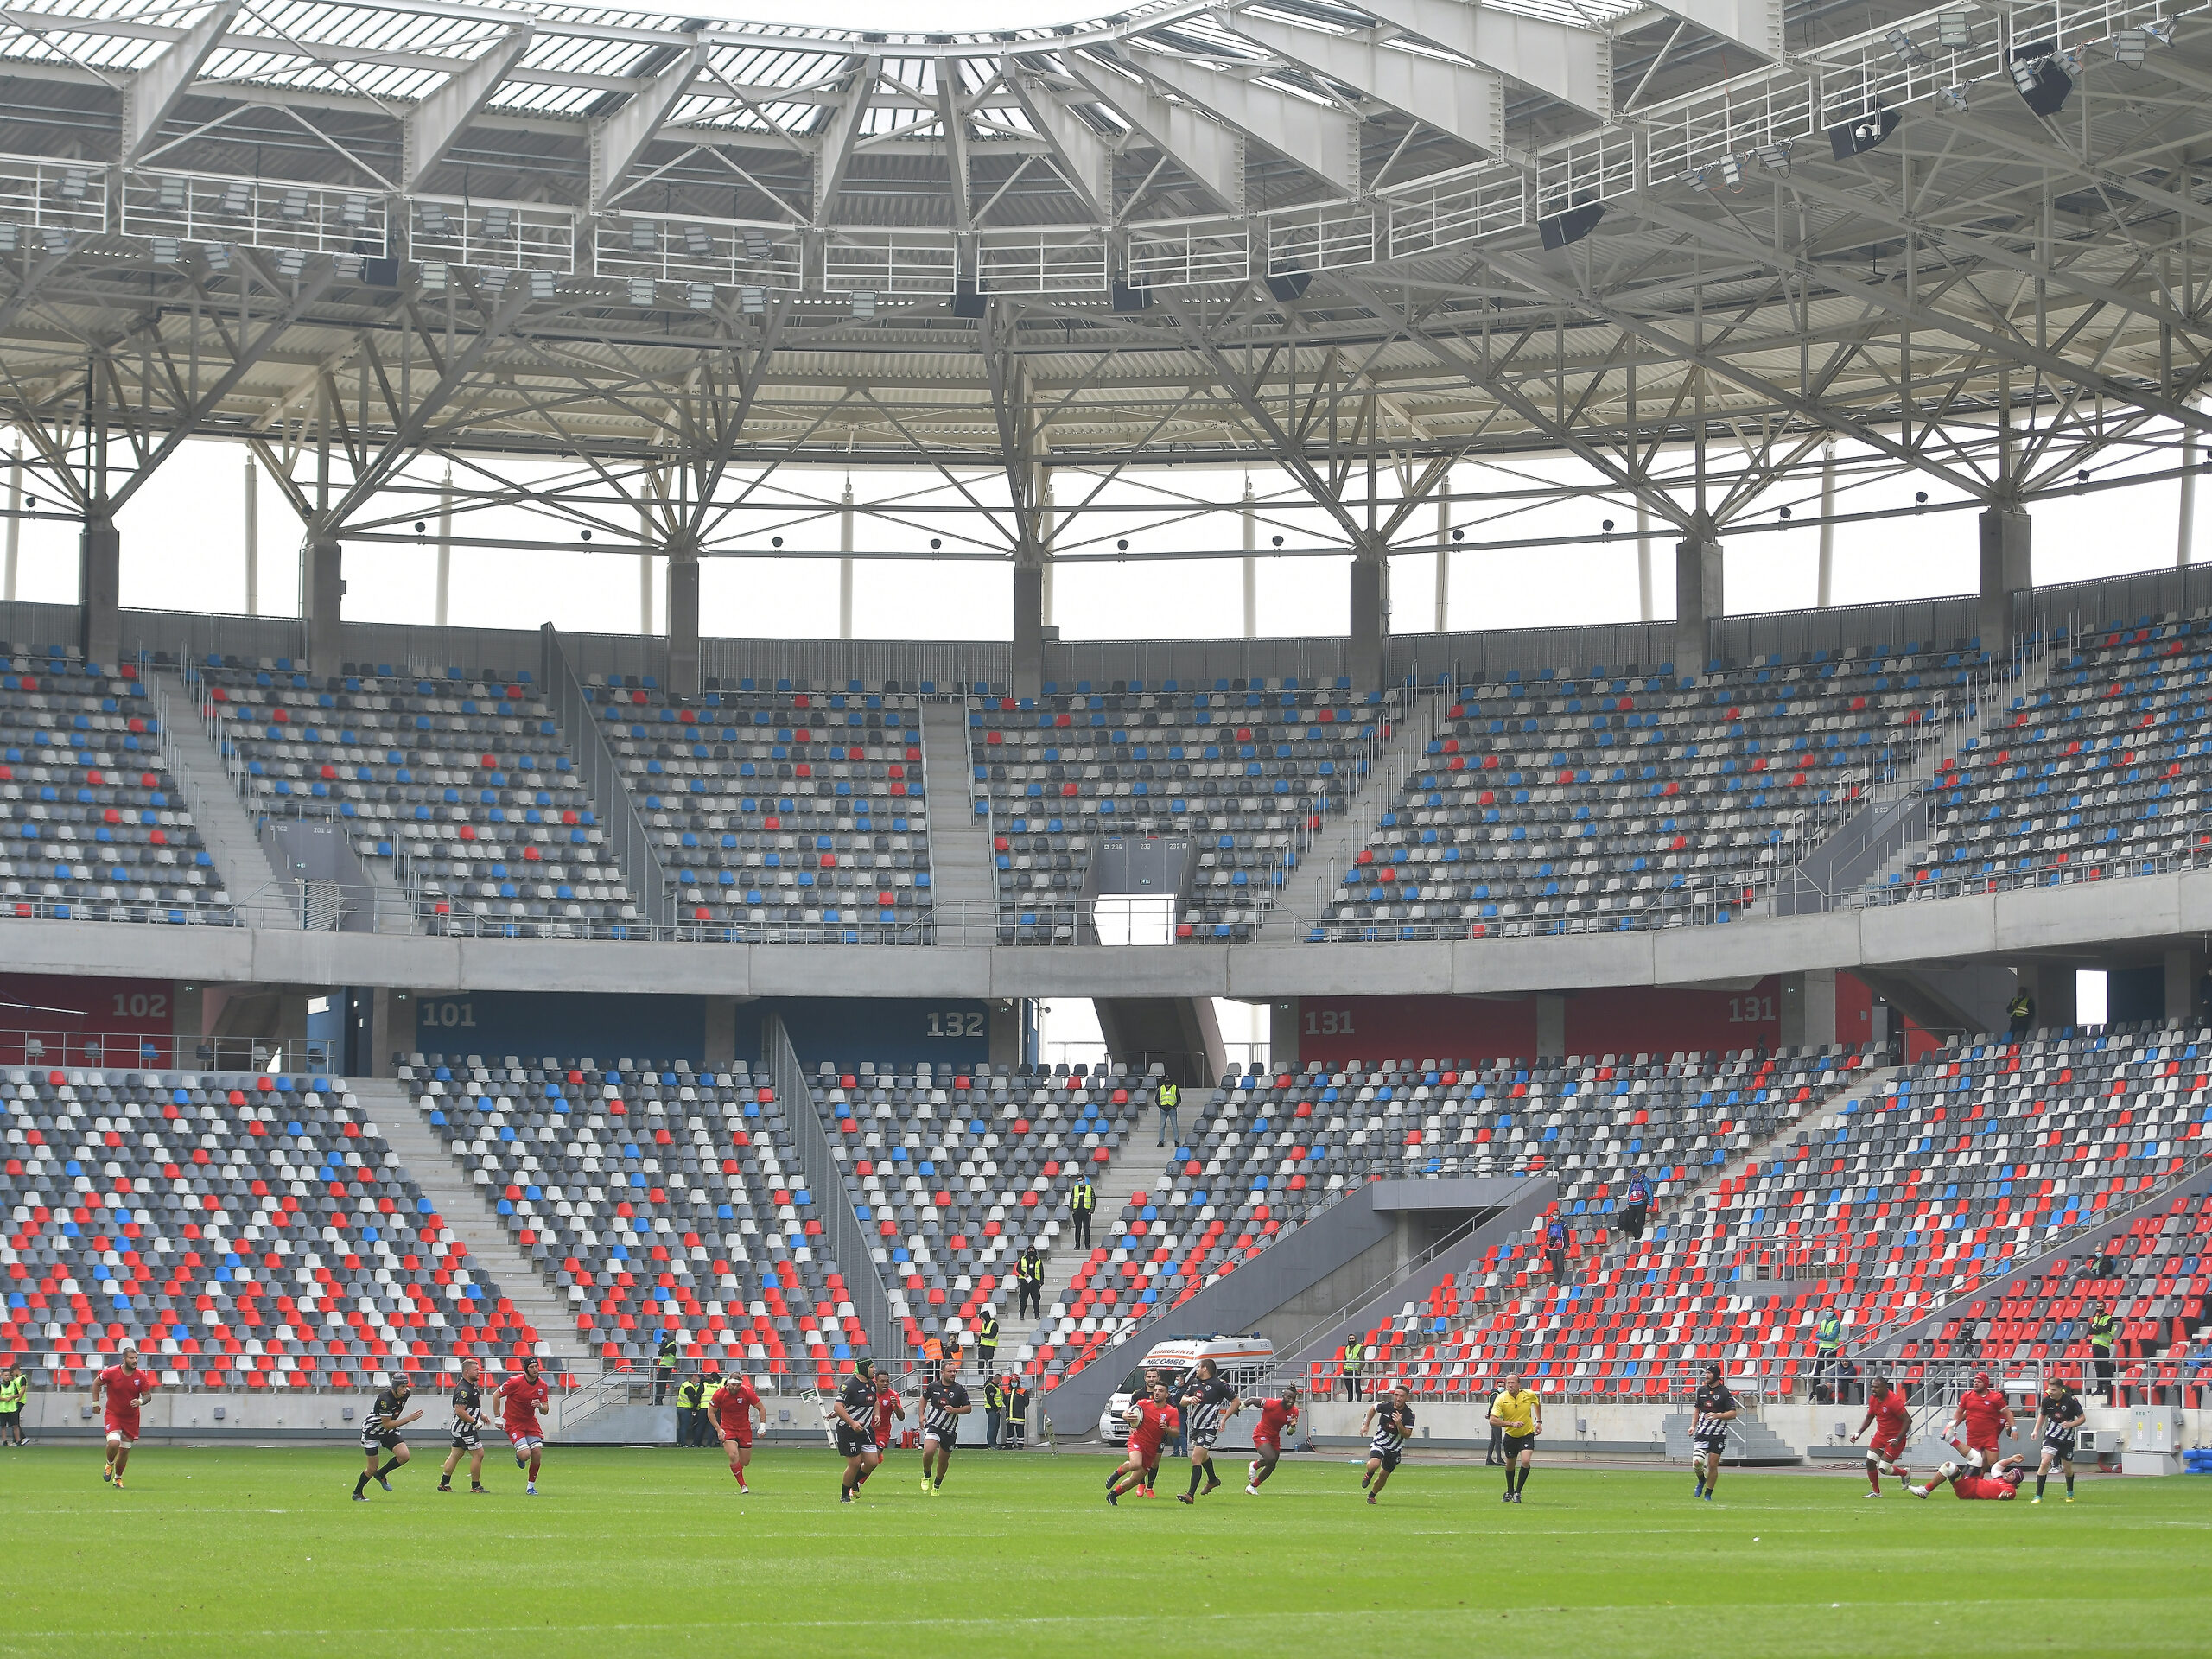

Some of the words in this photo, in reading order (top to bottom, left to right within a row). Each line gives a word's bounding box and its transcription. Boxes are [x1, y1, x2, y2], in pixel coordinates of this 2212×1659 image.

[113, 994, 166, 1017] 102
[423, 1002, 476, 1027] 101
[1729, 996, 1776, 1022] 131
[927, 1012, 984, 1037] 132
[1306, 1010, 1355, 1034] 131
